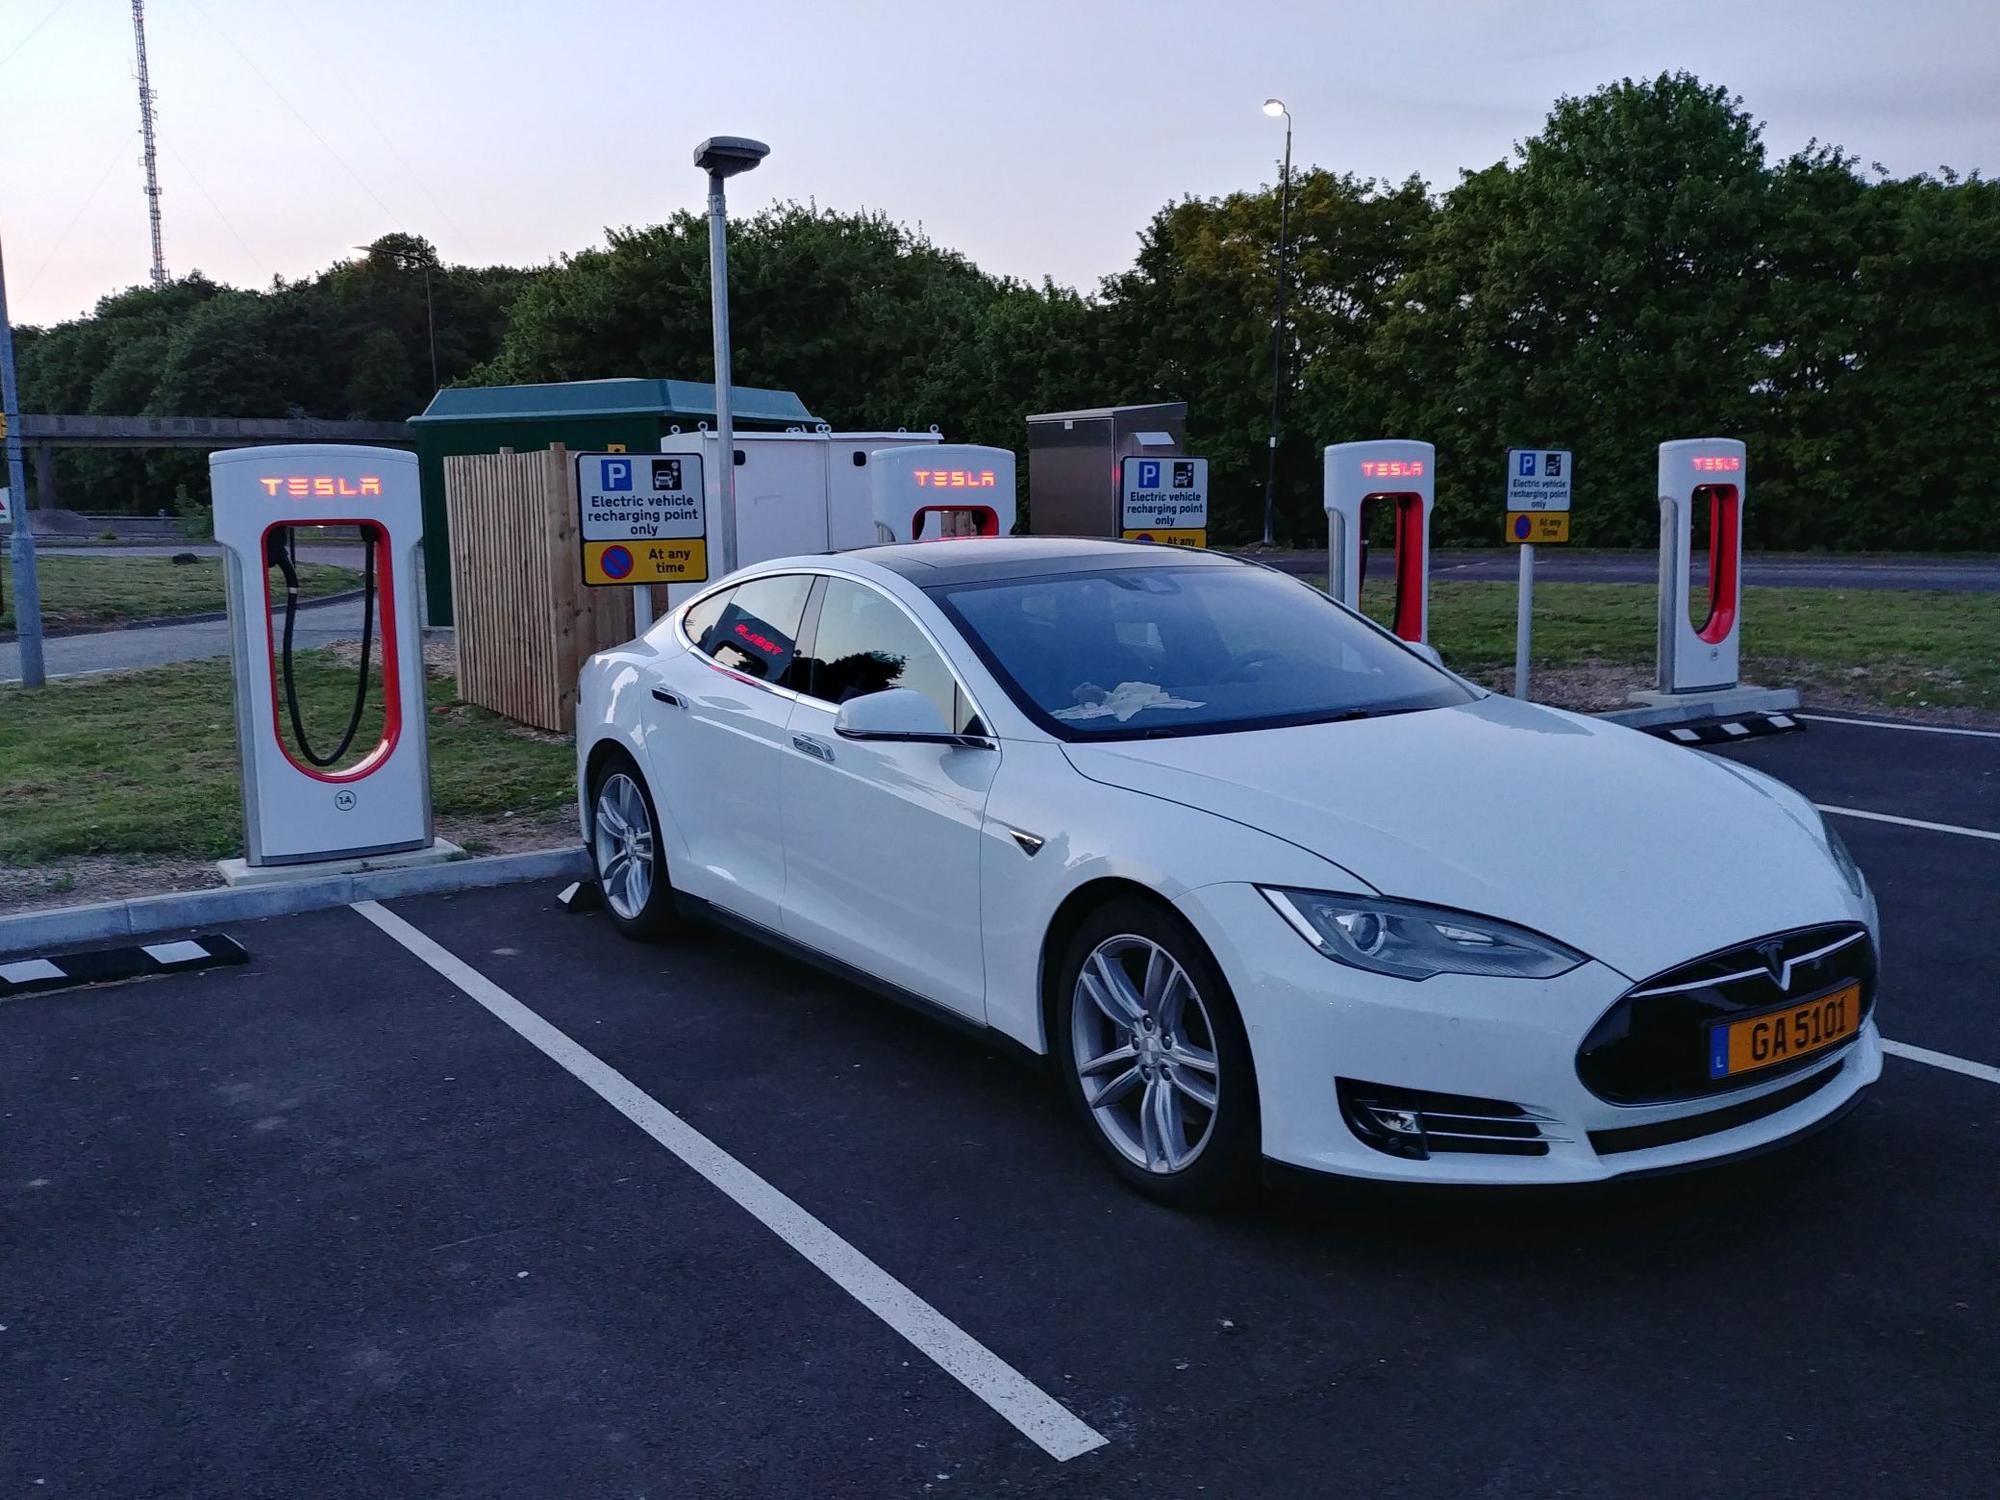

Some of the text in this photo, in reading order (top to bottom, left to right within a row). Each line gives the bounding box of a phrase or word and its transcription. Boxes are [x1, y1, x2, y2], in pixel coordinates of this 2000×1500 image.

[1361, 461, 1424, 477] TESLA
[1523, 456, 1533, 474] P
[1693, 457, 1740, 471] TESLA
[608, 463, 626, 488] P
[914, 470, 995, 487] TESLA
[1143, 465, 1156, 486] P
[259, 478, 382, 497] TESLA
[1513, 479, 1566, 488] Electric vehicle
[591, 495, 694, 507] Electric vehicle
[1130, 491, 1201, 501] Electric vehicle
[1549, 490, 1567, 499] point
[588, 509, 698, 522] recharging point
[1127, 503, 1203, 515] recharging point
[1155, 515, 1175, 526] only
[630, 523, 658, 536] only
[1167, 536, 1196, 546] At any
[649, 548, 691, 560] At any
[656, 562, 685, 573] time
[338, 795, 352, 804] 1A
[1751, 995, 1848, 1061] GA 5101
[1715, 1055, 1724, 1068] L
